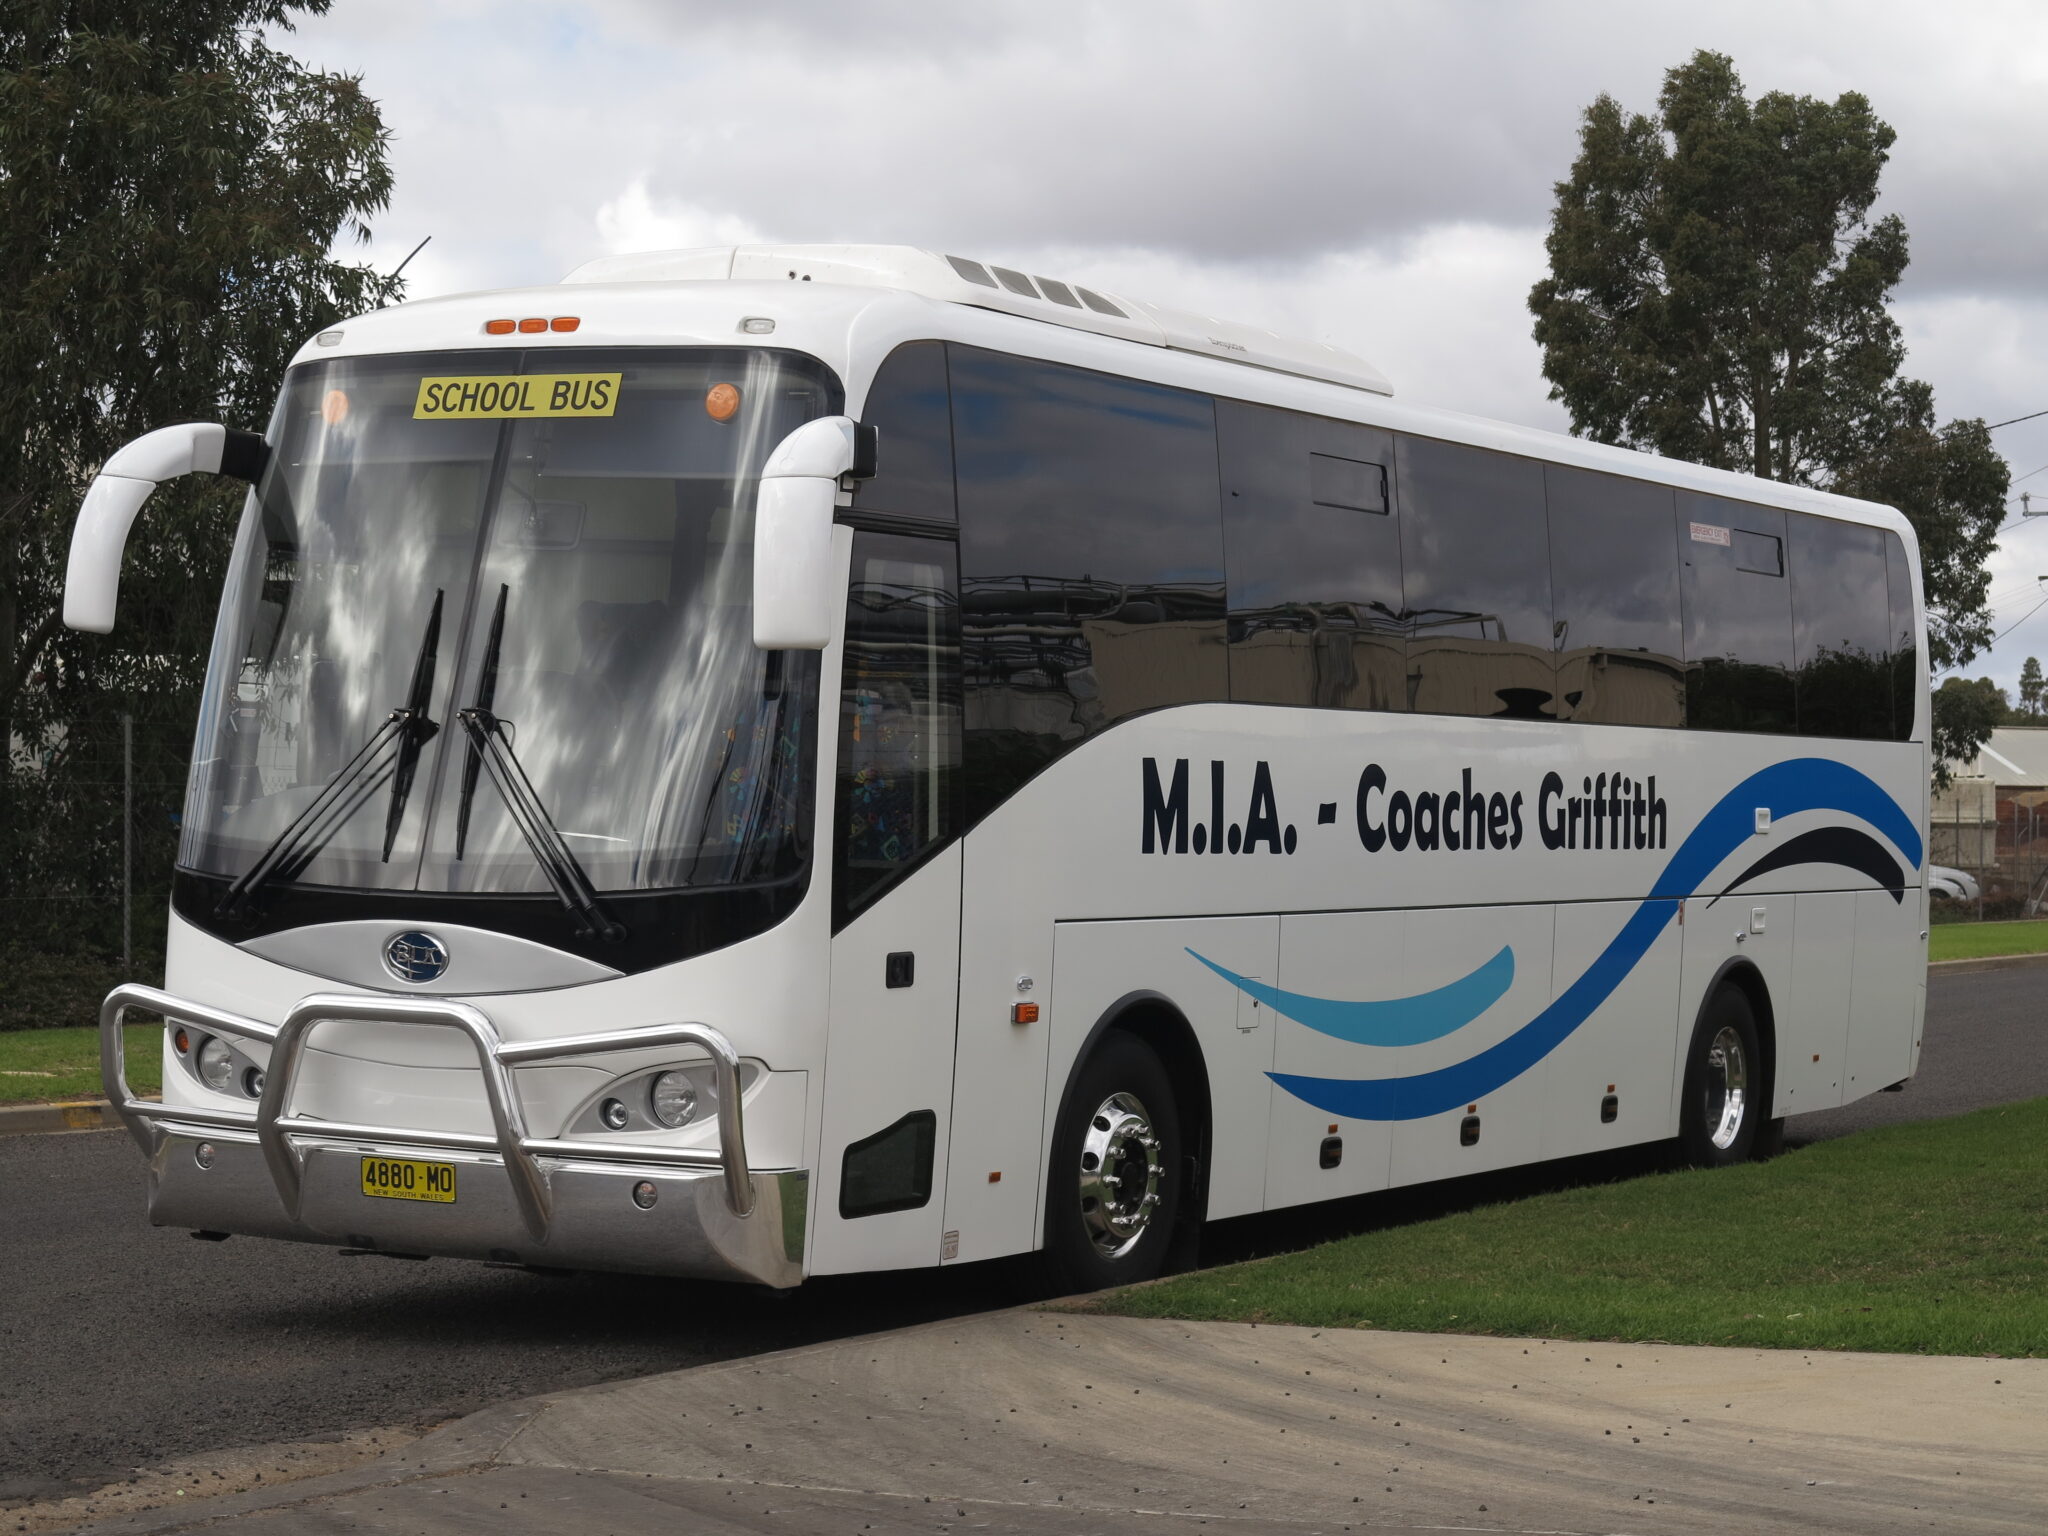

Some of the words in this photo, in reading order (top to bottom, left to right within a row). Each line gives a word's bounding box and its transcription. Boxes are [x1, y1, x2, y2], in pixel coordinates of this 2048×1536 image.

[423, 382, 535, 412] SCHOOL
[549, 380, 612, 410] BUS
[1141, 757, 1298, 855] M.I.A.
[1356, 763, 1523, 853] Coaches
[1538, 771, 1668, 851] Griffith
[393, 1190, 417, 1198] SOUTH
[420, 1192, 445, 1201] WALES
